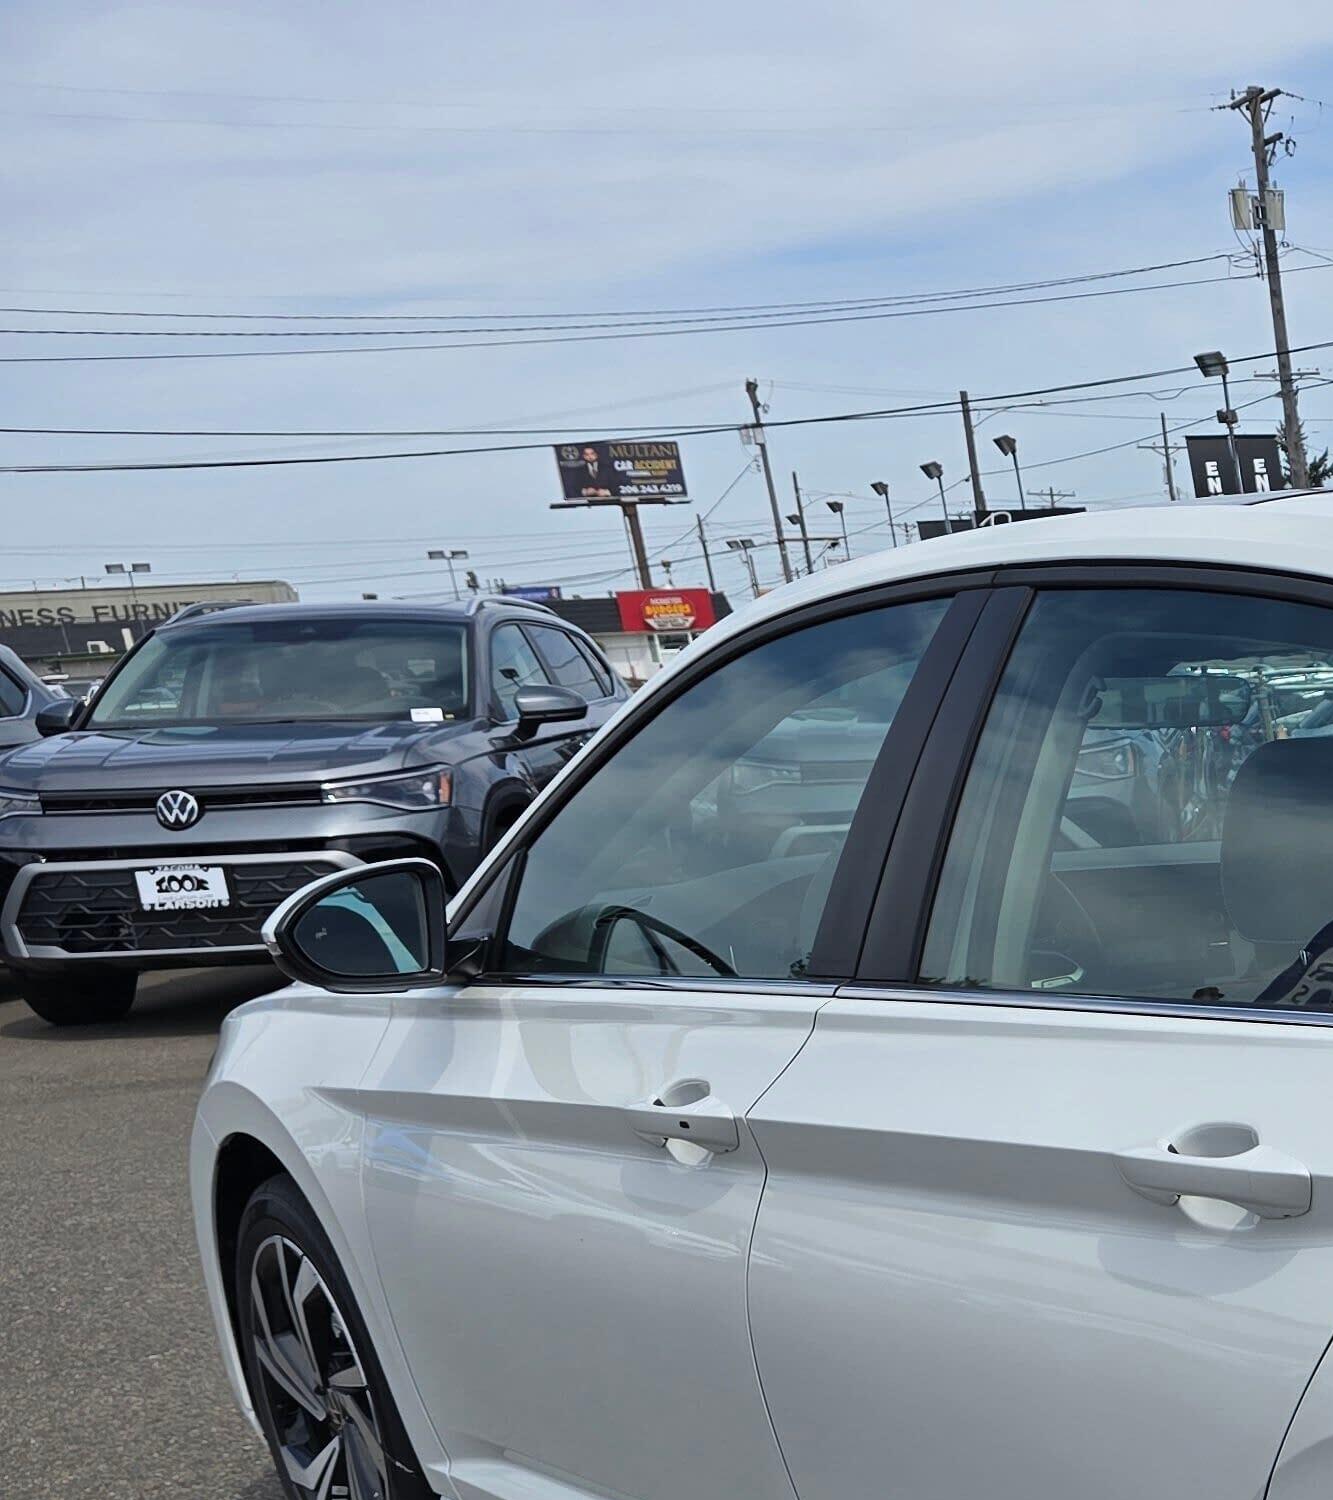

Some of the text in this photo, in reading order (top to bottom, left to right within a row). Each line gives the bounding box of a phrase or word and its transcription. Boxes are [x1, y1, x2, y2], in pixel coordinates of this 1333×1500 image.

[608, 444, 678, 458] MULTANI
[614, 460, 633, 471] CAR
[157, 863, 202, 873] TACOMA
[154, 898, 219, 911] LARSON
